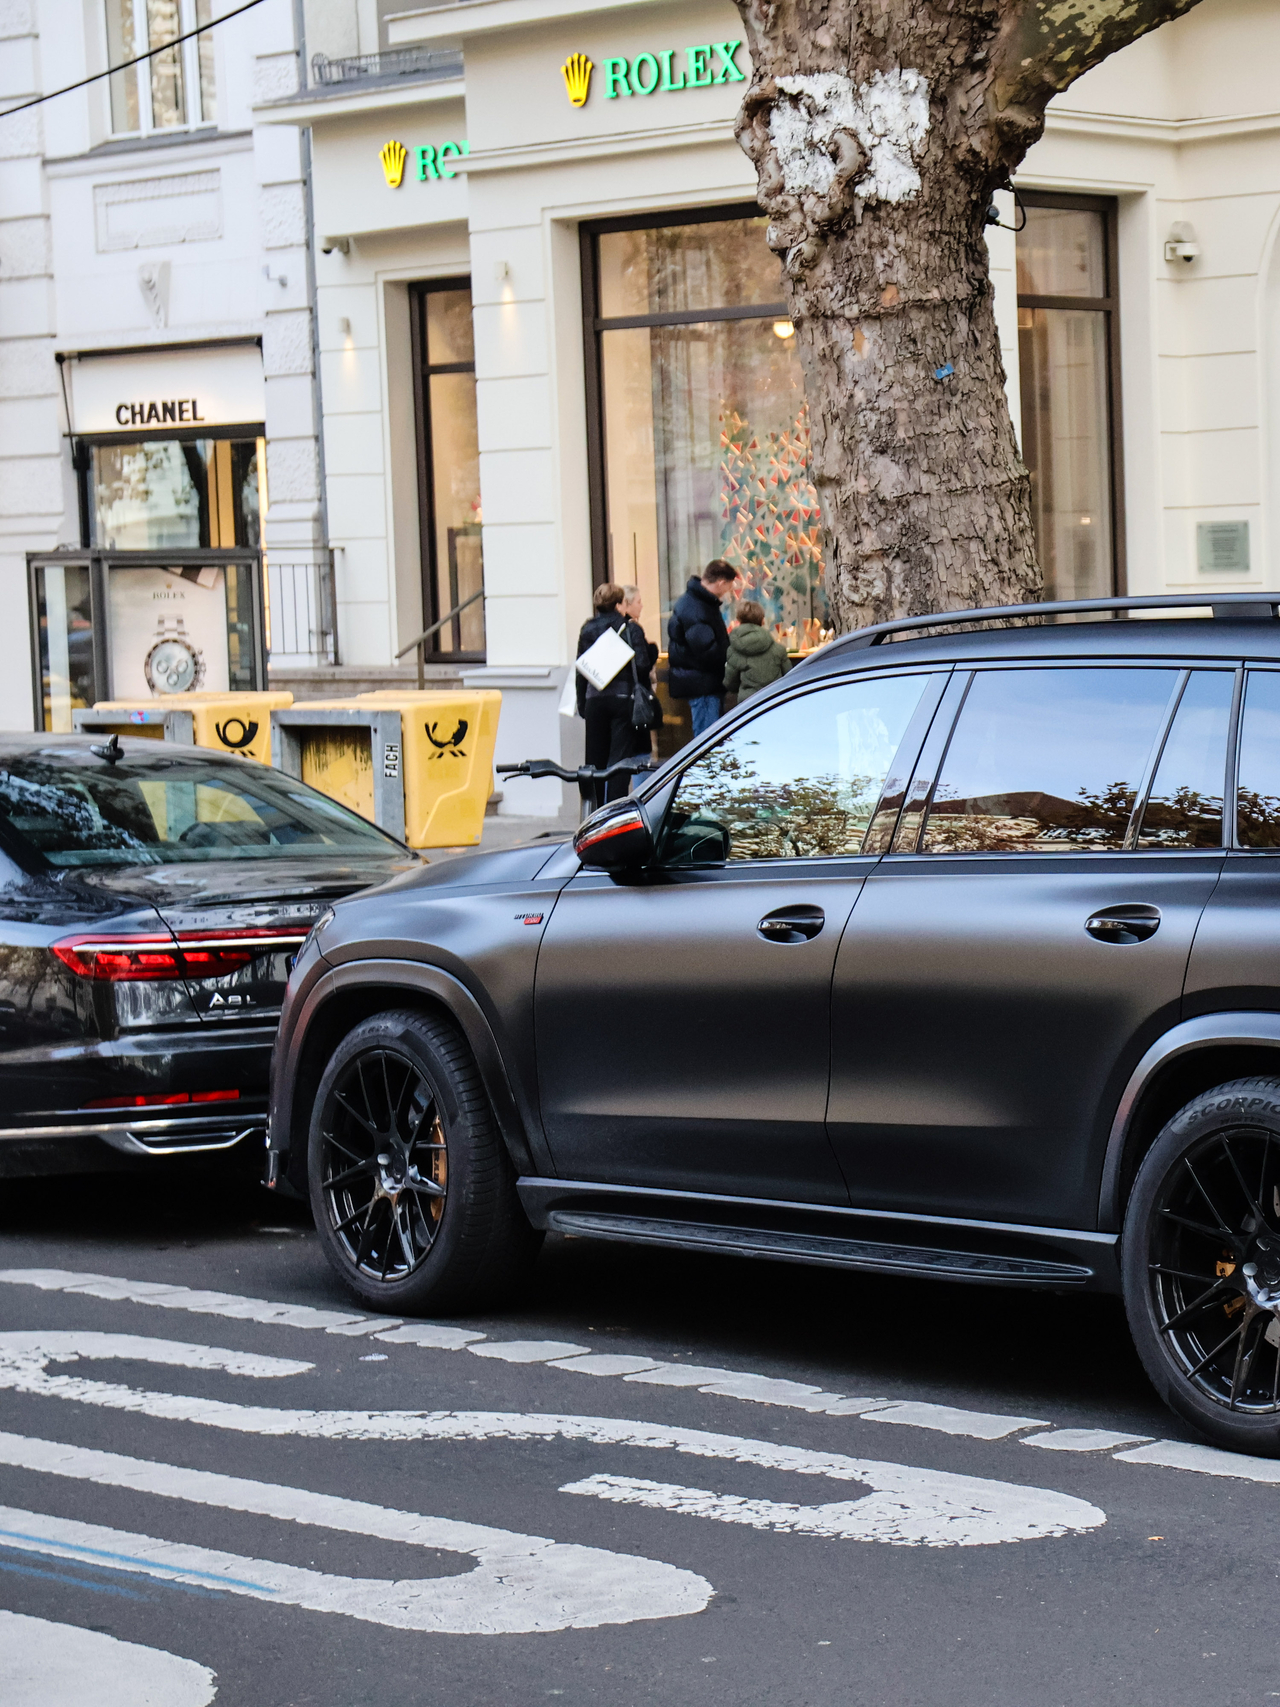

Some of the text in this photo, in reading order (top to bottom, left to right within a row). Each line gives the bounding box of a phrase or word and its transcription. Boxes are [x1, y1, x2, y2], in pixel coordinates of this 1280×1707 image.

[602, 40, 745, 98] ROLEX
[115, 399, 205, 425] CHANEL
[153, 591, 185, 599] ROLEX
[385, 745, 398, 778] FACH
